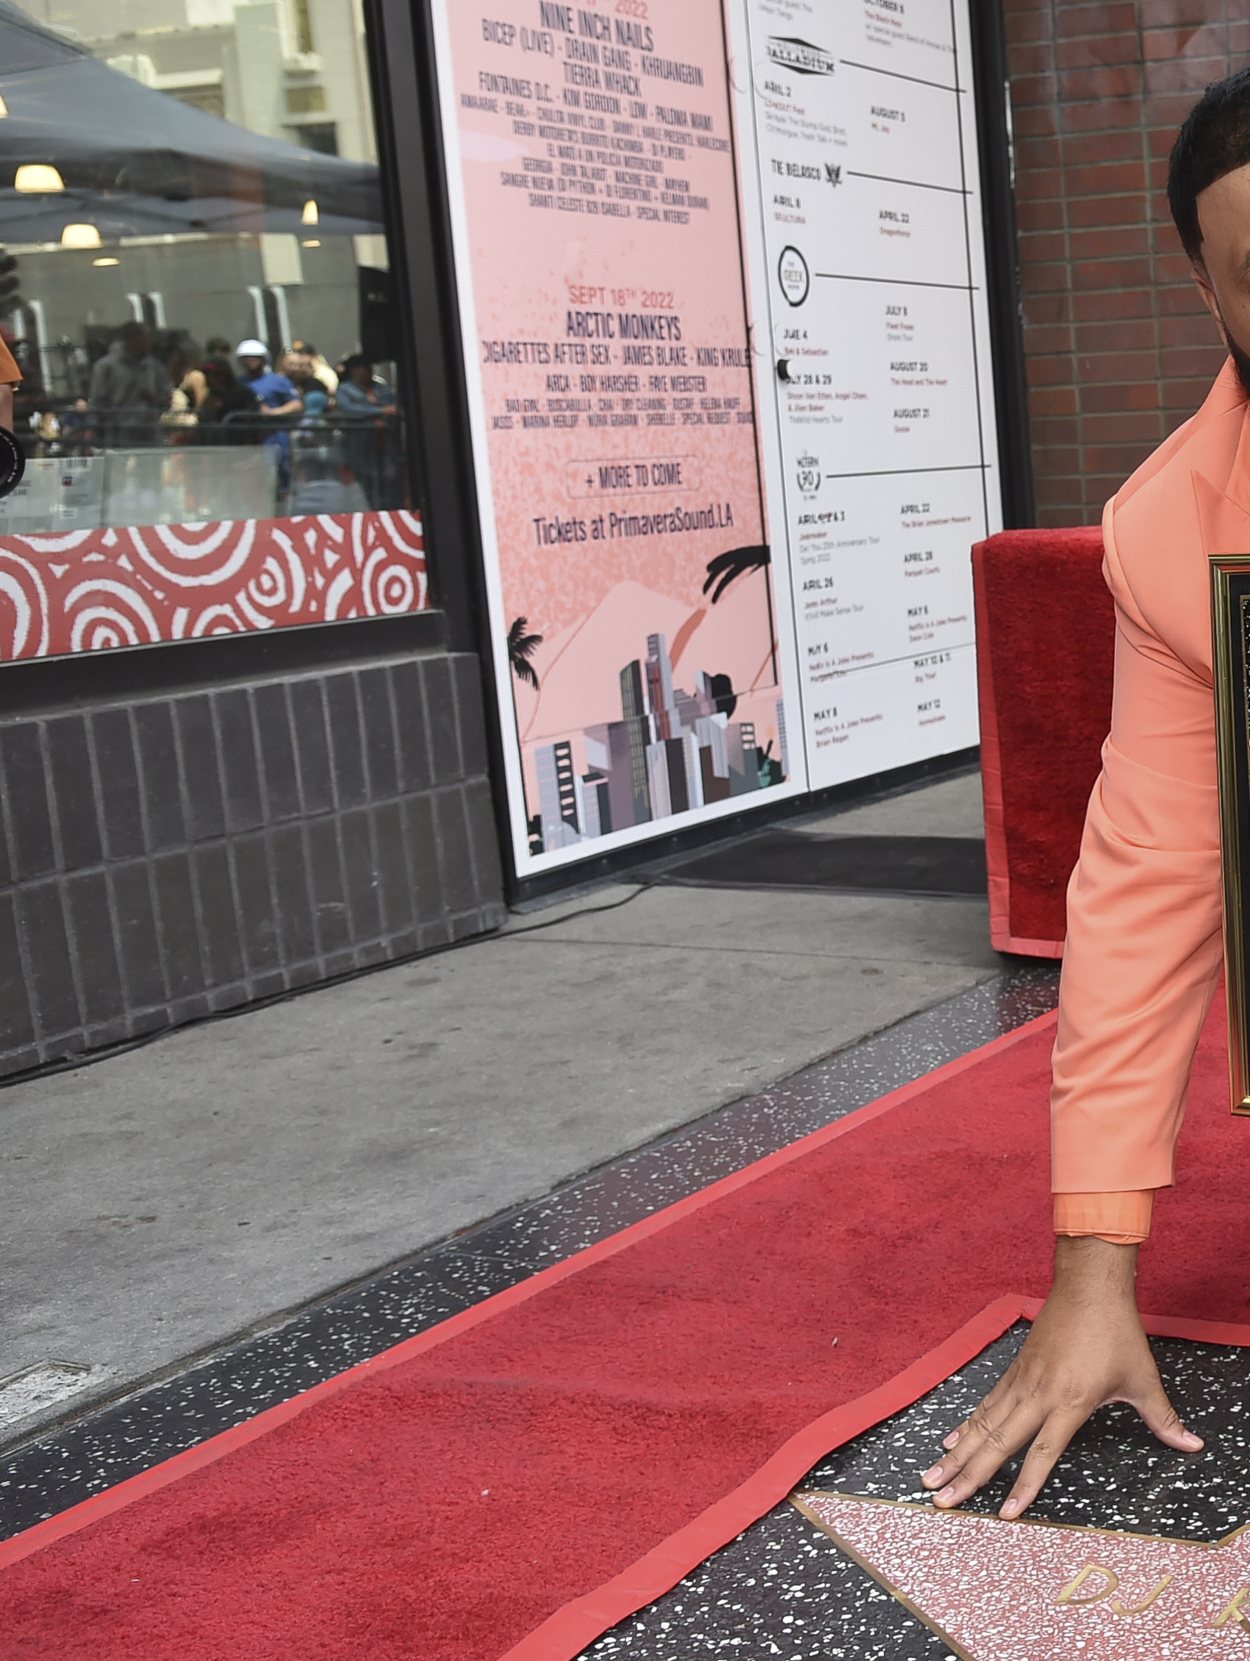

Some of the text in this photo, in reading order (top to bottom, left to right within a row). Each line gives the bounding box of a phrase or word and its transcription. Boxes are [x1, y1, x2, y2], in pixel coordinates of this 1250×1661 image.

[540, 1, 654, 52] NINE INCH NAILS
[482, 18, 517, 47] BICEP
[565, 36, 599, 64] DRAIN
[603, 45, 632, 72] GANG
[569, 284, 605, 305] SEPT
[641, 291, 675, 309] 2022
[566, 310, 681, 341] ARCTIC MONKEYS
[554, 342, 588, 365] AFTER
[591, 343, 612, 365] SEX
[623, 345, 655, 366] JAMES
[656, 346, 688, 367] BLAKE
[696, 347, 719, 367] KING
[546, 374, 571, 393] ARCA
[598, 465, 632, 490] MORE
[634, 464, 649, 487] TO
[652, 462, 683, 486] COME
[533, 503, 734, 546] Tickets at PrimaveraSound.LA
[1055, 1563, 1174, 1617] DJ
